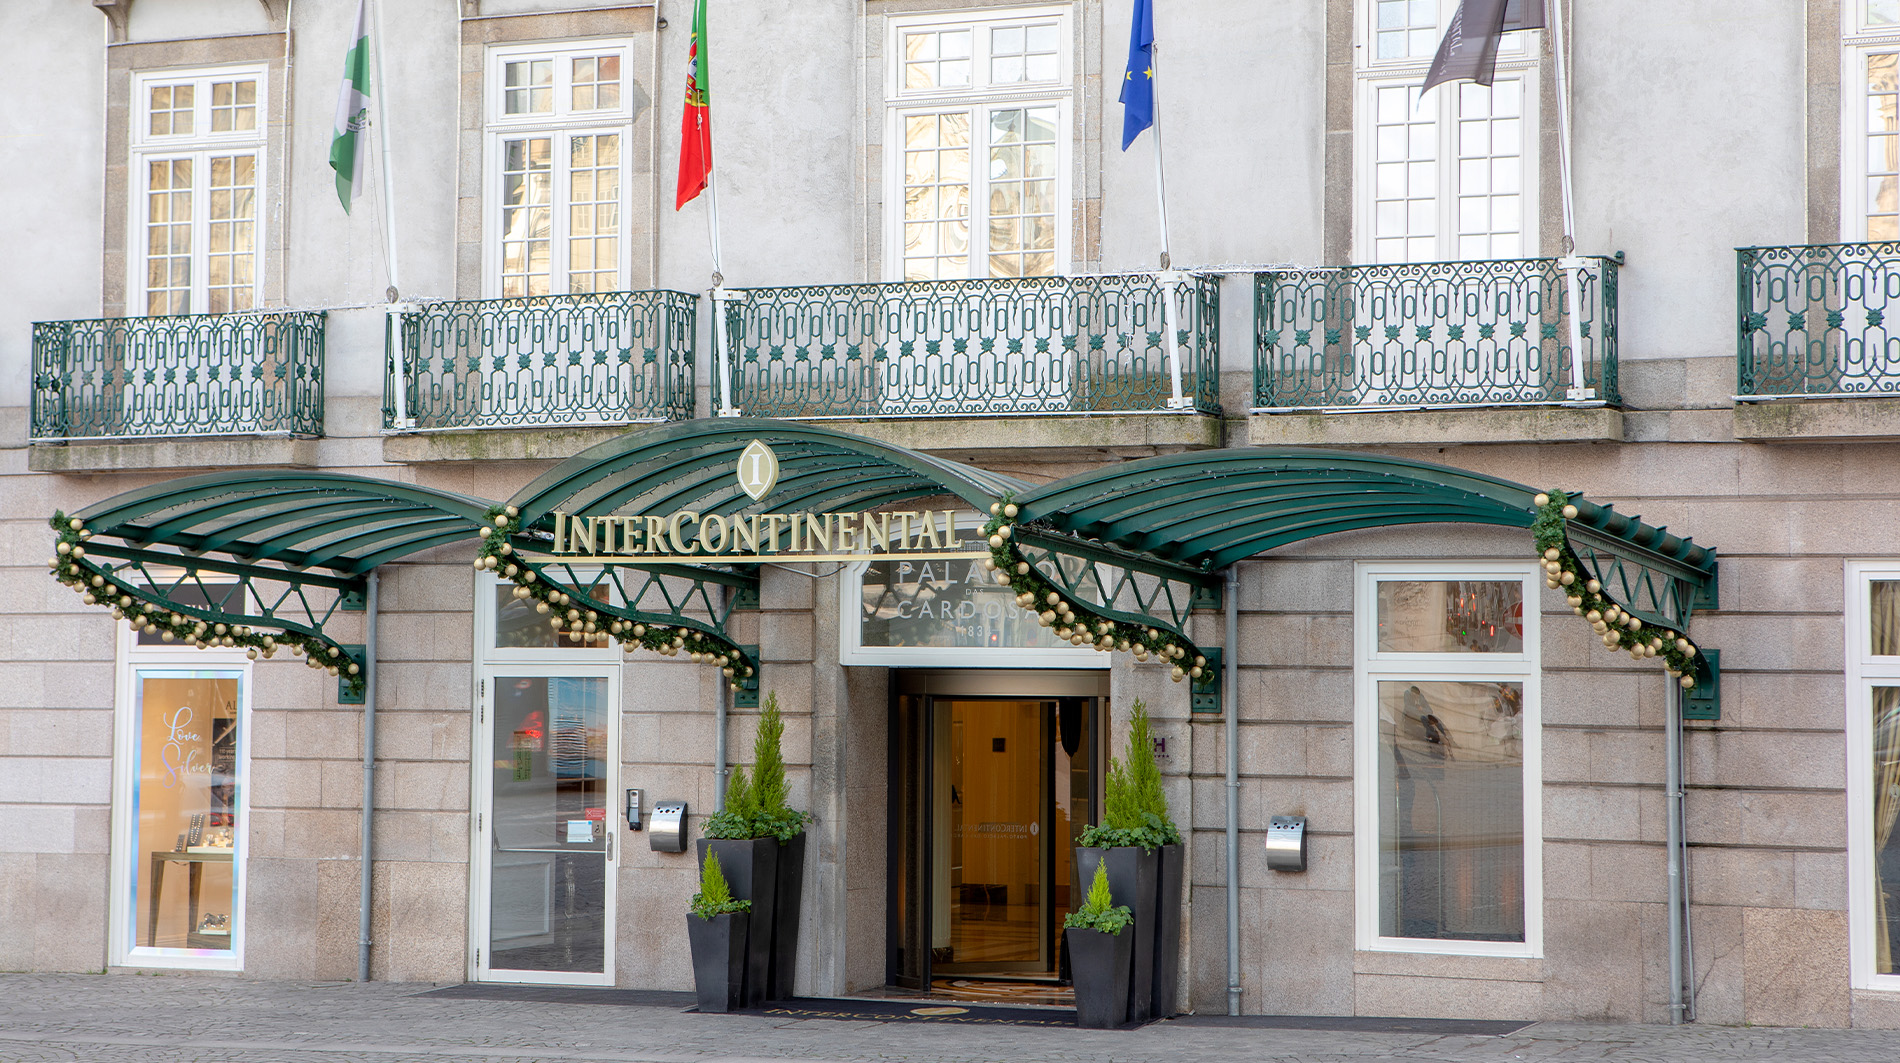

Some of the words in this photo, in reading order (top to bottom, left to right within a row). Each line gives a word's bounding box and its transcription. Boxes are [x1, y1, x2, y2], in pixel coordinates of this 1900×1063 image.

[551, 509, 965, 554] INTERCONTINENTAL
[899, 560, 1056, 585] PALAO
[965, 588, 984, 596] DAS
[897, 600, 1042, 619] CARDOSA
[164, 706, 201, 745] Love
[1153, 738, 1165, 752] H
[161, 742, 217, 789] Silver
